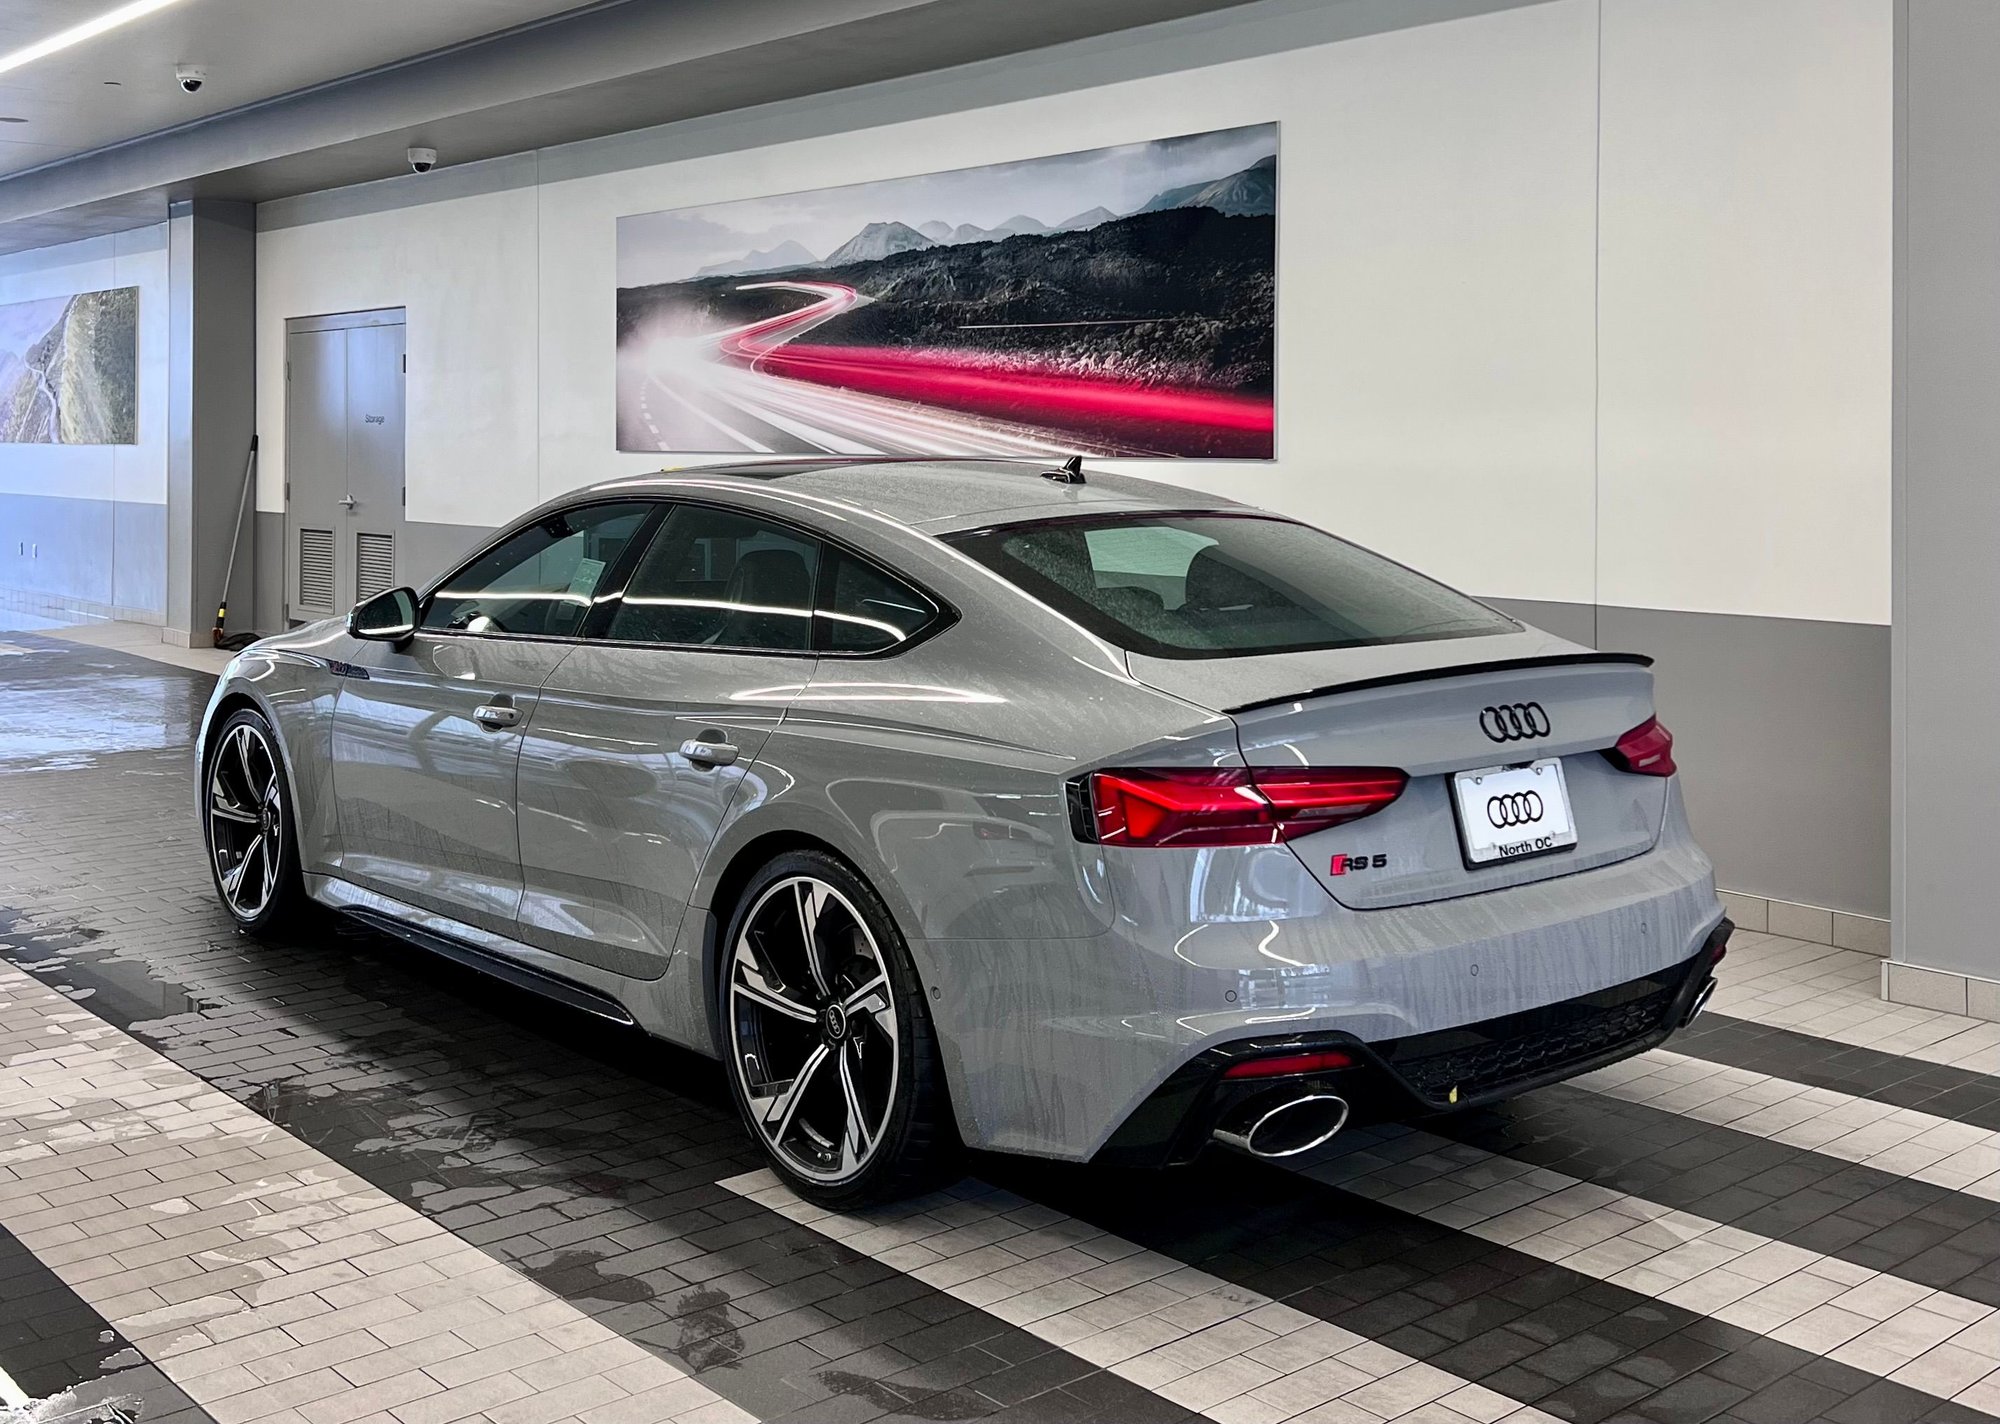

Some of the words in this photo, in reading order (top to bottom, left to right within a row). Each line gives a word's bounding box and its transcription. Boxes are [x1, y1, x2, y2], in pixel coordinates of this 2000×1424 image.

[365, 413, 385, 425] Storage
[1499, 841, 1533, 857] North
[1535, 837, 1553, 849] OC
